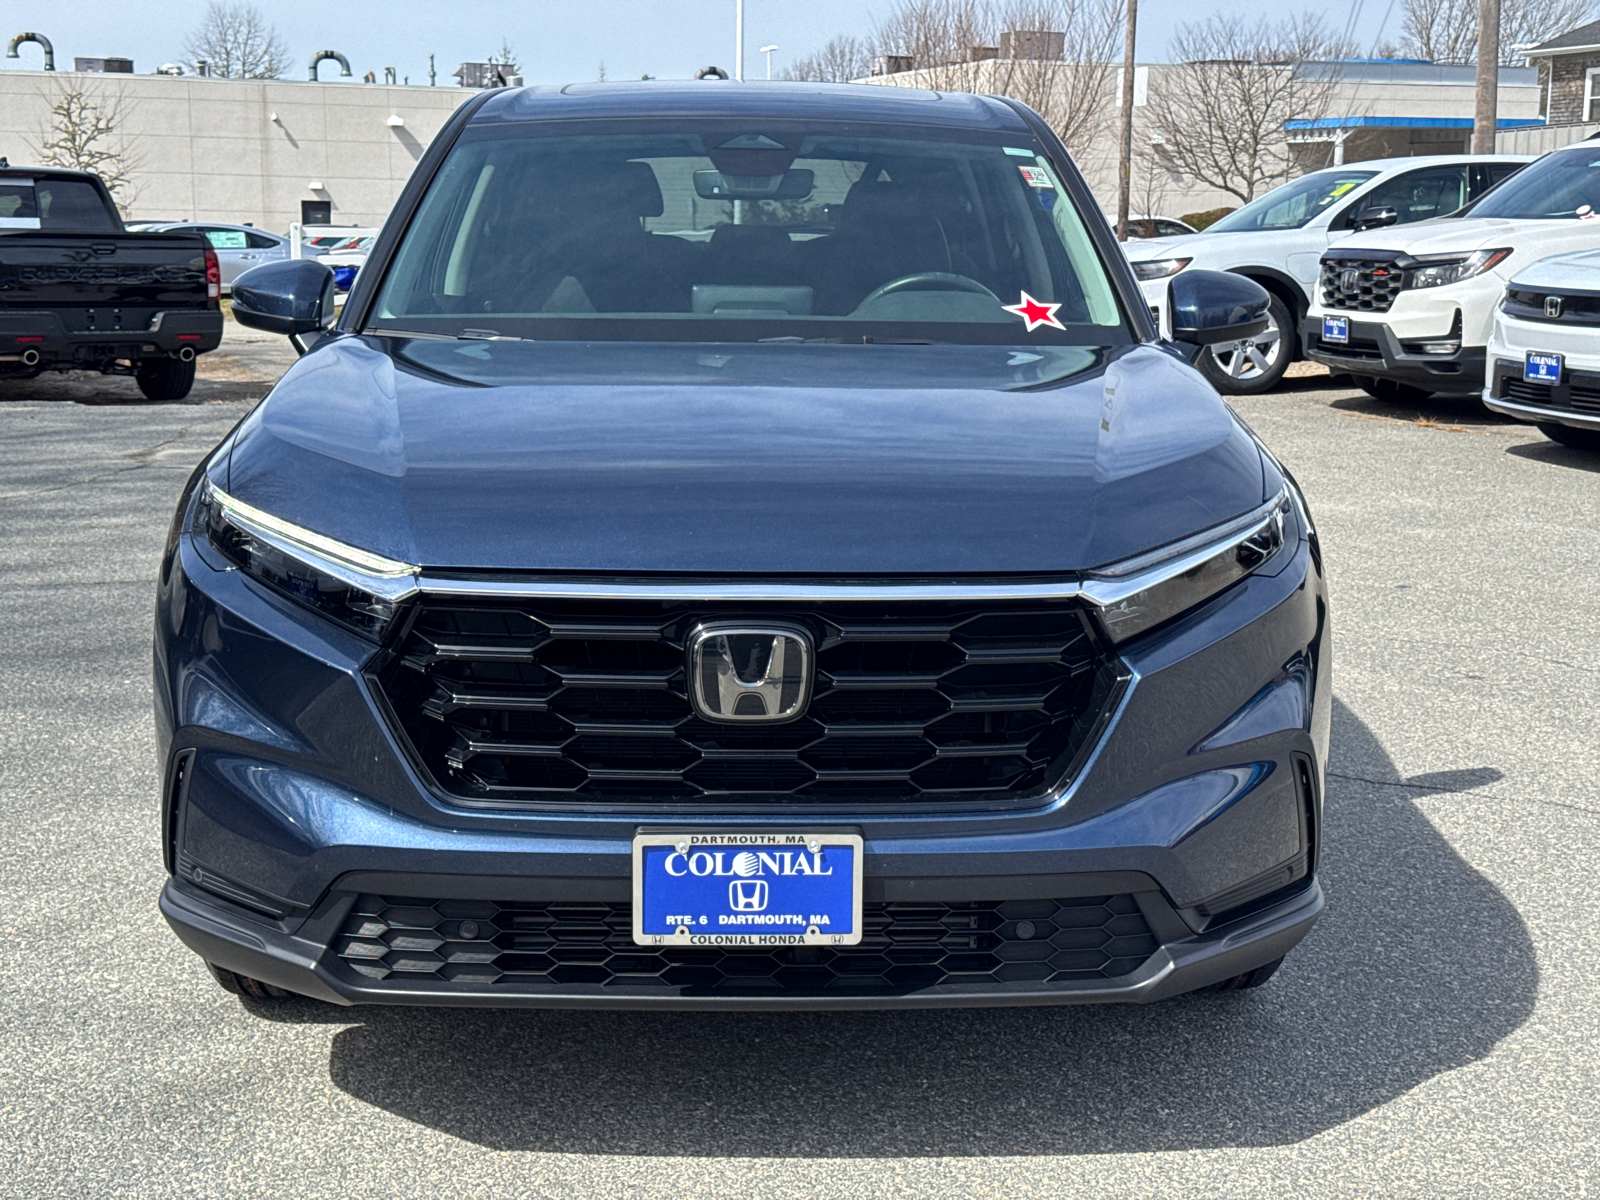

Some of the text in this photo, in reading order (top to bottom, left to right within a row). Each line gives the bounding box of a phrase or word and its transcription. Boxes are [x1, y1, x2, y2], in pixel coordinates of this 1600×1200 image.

[691, 835, 806, 845] DARTMOUTH, MA
[664, 851, 833, 877] COLONIAL
[666, 914, 830, 926] RTE. 6 DARTMOUTH, MA
[690, 935, 806, 945] COLONIAL HONDA
